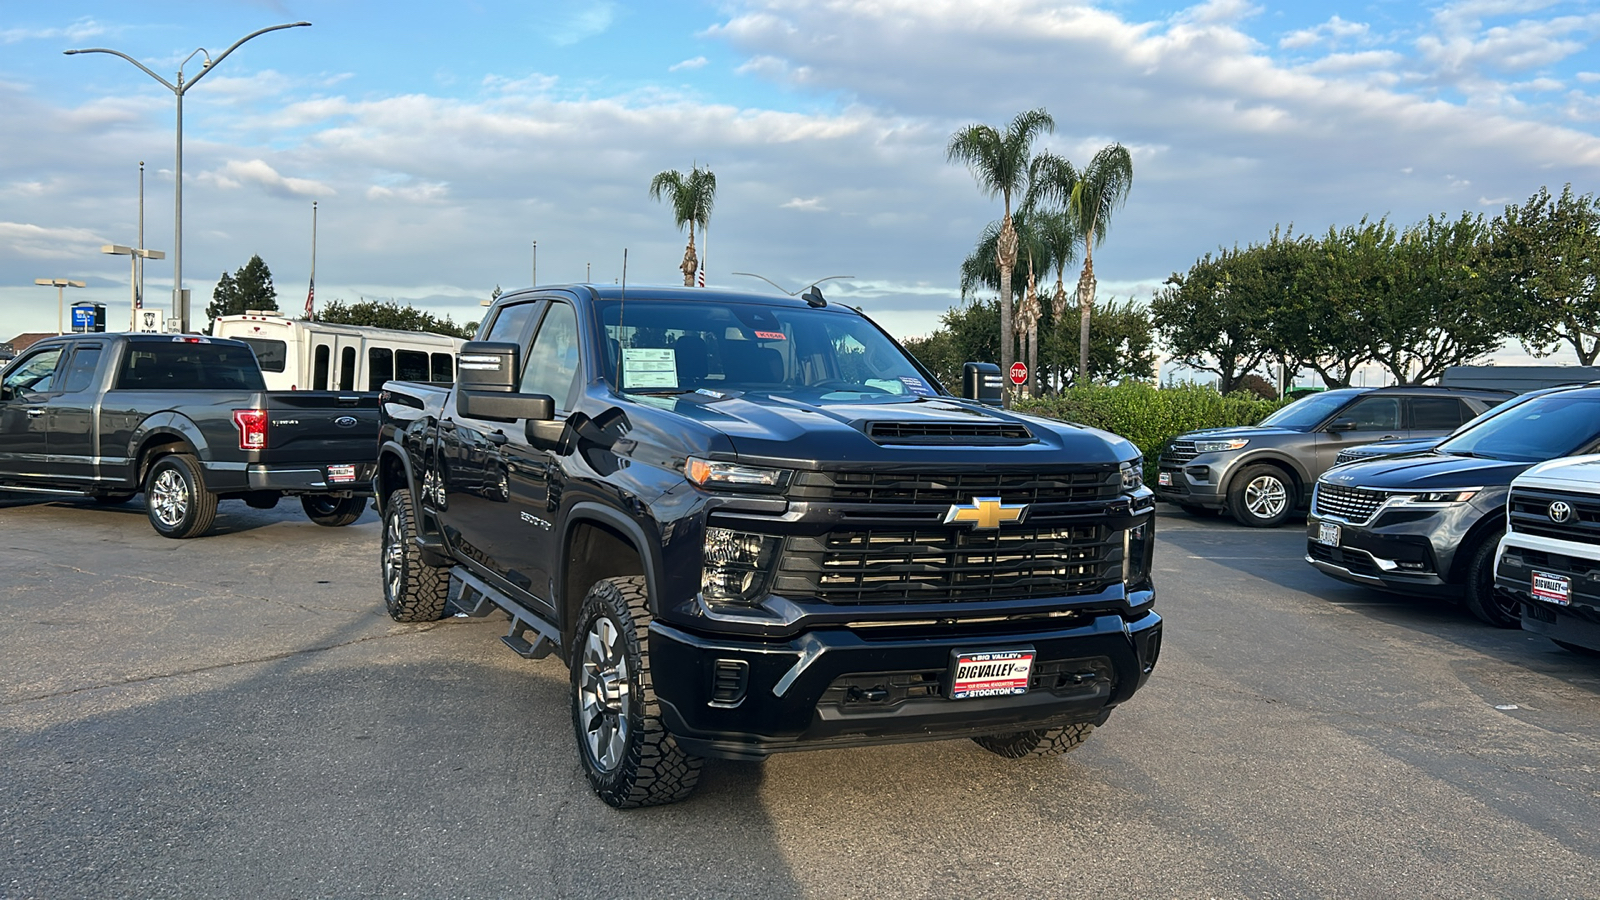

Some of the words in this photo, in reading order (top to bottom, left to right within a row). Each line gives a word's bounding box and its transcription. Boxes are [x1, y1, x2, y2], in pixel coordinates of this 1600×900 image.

[1011, 369, 1026, 378] STOP
[1535, 579, 1562, 592] BIGVALLEY
[992, 652, 1018, 660] VALLEY
[957, 663, 1015, 679] BIGVALLEY
[969, 688, 1011, 697] STOCKTON
